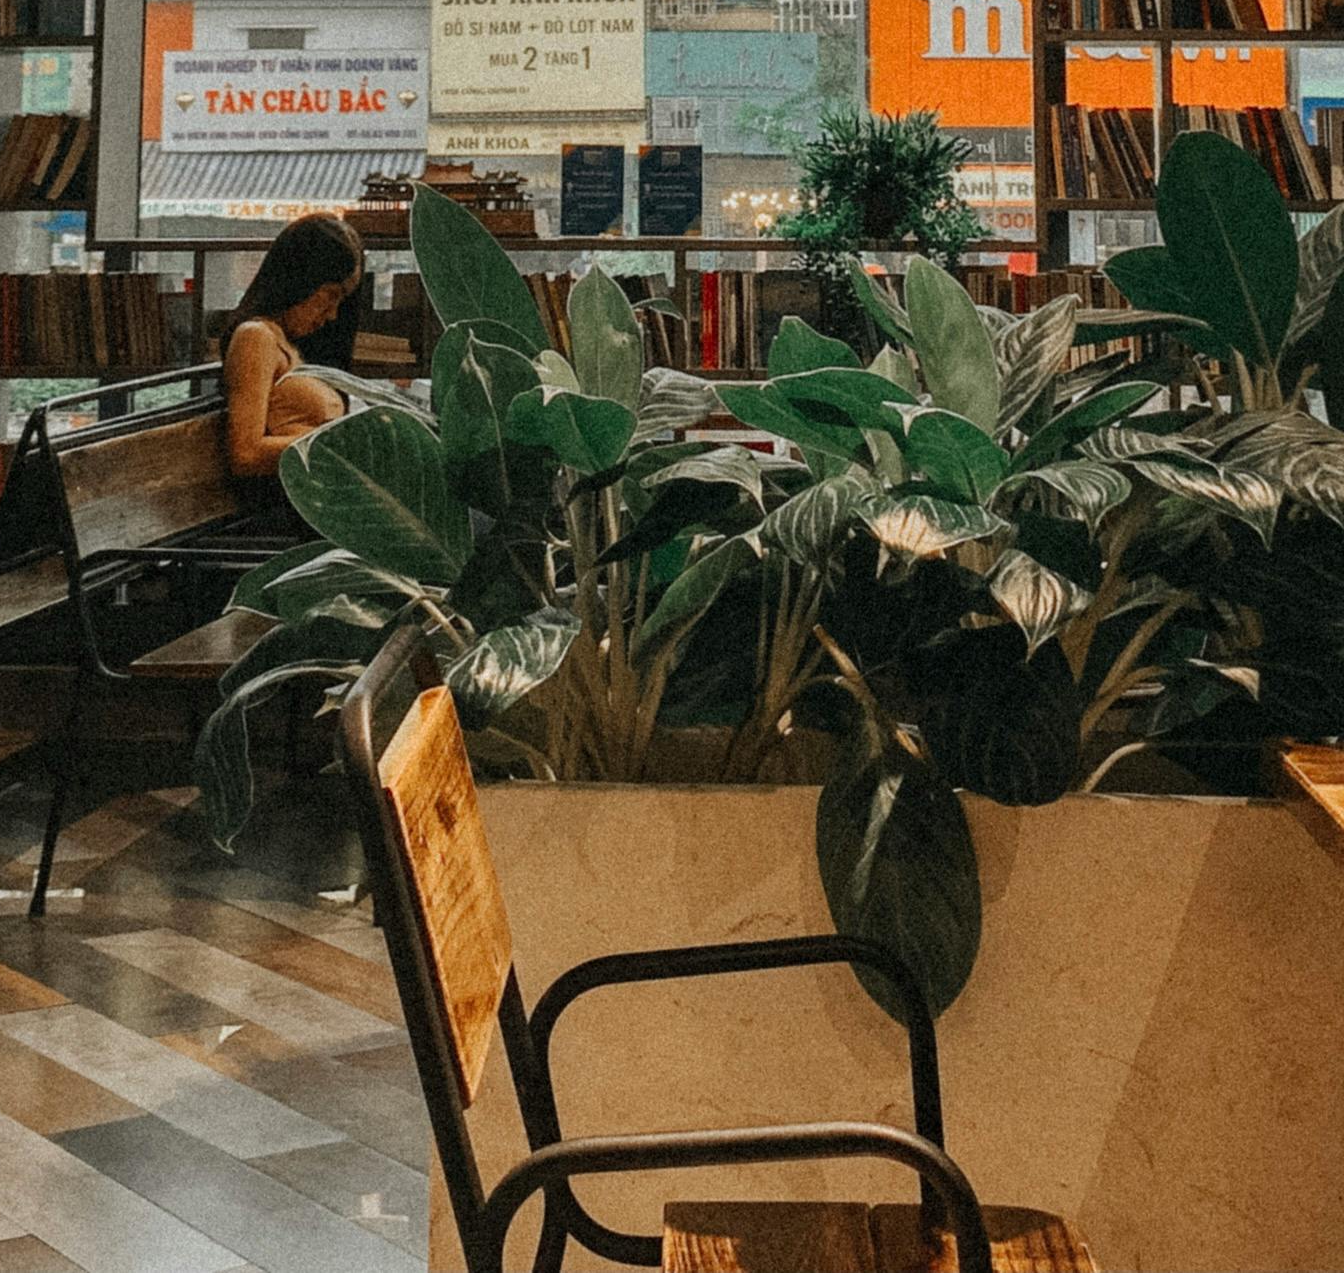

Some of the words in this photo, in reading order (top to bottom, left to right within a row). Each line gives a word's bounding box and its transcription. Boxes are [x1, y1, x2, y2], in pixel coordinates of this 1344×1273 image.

[489, 20, 522, 36] NAM
[601, 18, 634, 33] NAM
[489, 52, 519, 67] MUA
[522, 46, 538, 71] 2
[581, 45, 591, 70] 1
[205, 82, 256, 114] TÂN
[261, 81, 331, 114] CHÂU
[338, 76, 388, 113] BẮC
[446, 137, 479, 150] ANH
[484, 137, 530, 150] KHOA
